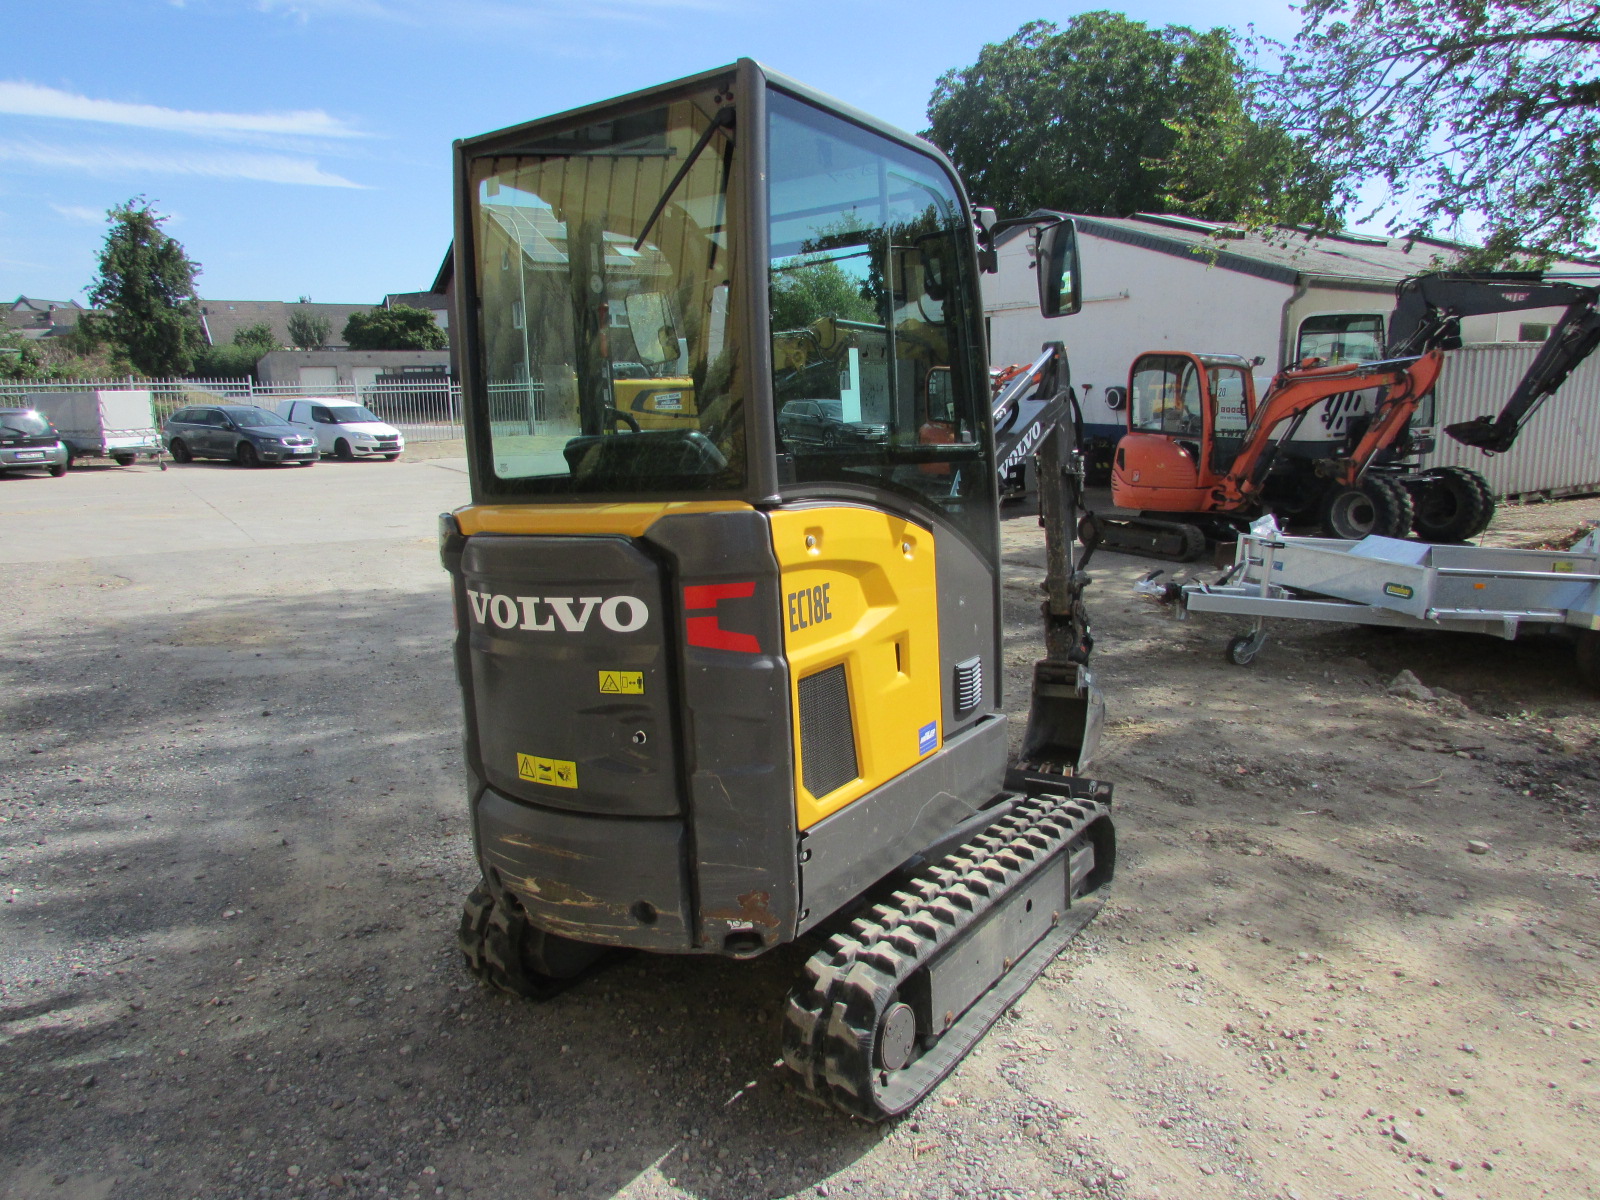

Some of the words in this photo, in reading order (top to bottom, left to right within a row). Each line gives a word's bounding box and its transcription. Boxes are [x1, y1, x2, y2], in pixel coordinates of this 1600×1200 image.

[997, 421, 1041, 480] VOLVO
[466, 588, 649, 633] VOLVO
[788, 582, 833, 633] EC18E
